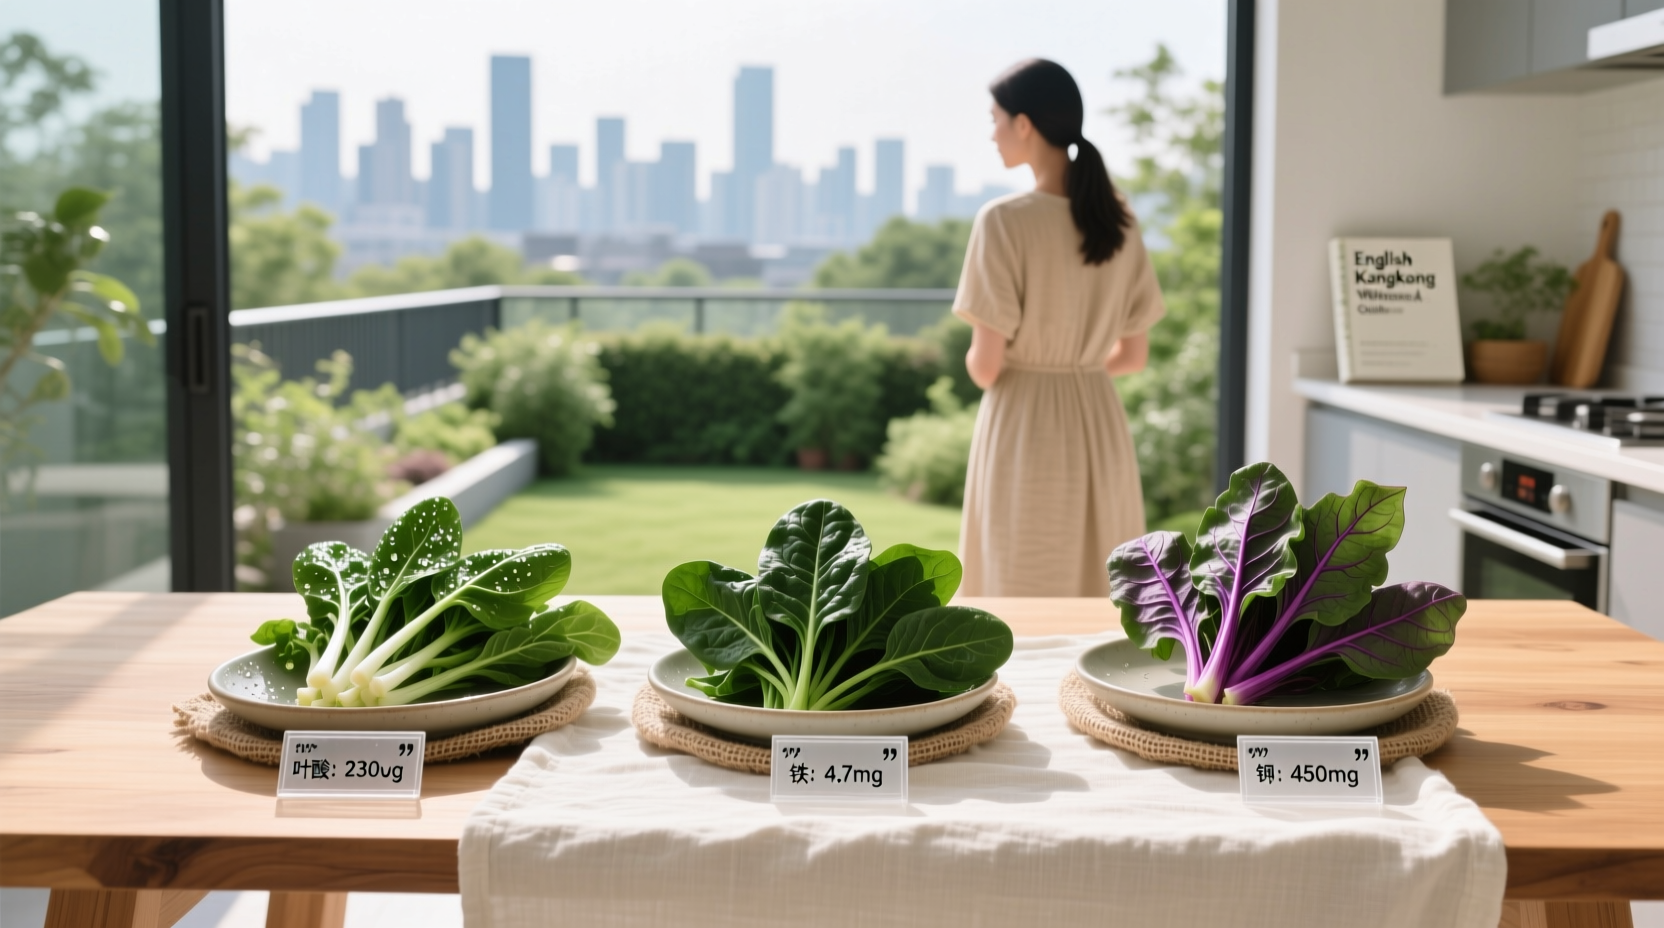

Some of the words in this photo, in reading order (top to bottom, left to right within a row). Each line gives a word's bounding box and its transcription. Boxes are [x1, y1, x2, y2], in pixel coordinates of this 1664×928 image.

[1354, 251, 1412, 270] English
[1355, 270, 1435, 289] Kangkong
[824, 764, 883, 788] 4.7mg
[1290, 764, 1359, 788] 450mg
